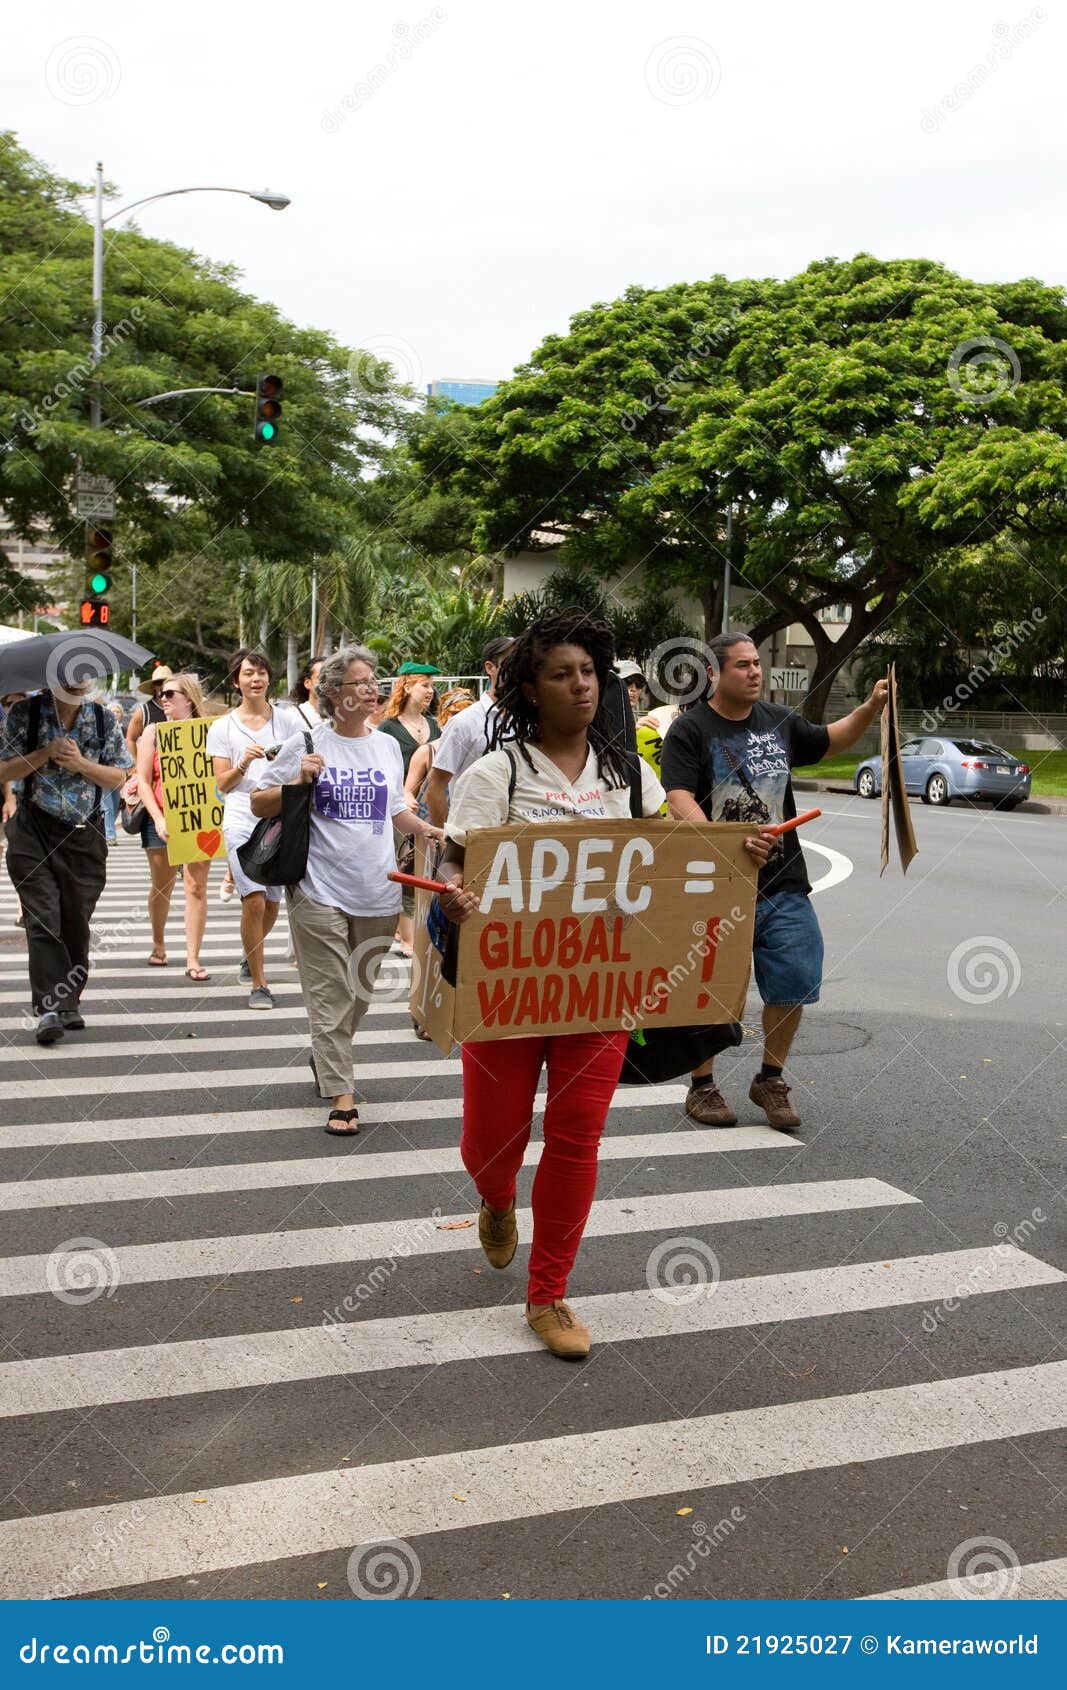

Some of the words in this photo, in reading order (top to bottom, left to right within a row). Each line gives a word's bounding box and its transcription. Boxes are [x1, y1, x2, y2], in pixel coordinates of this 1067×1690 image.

[158, 727, 183, 753] WE
[160, 756, 187, 782] FOR
[317, 767, 389, 786] APEC
[166, 782, 207, 809] WITH
[333, 786, 376, 802] GREED
[179, 809, 202, 832] IN
[211, 806, 224, 826] O
[338, 802, 371, 818] NEED
[479, 837, 655, 914] APEC
[684, 860, 716, 893] =
[479, 916, 631, 970] GLOBAL
[476, 966, 669, 1028] WARMING
